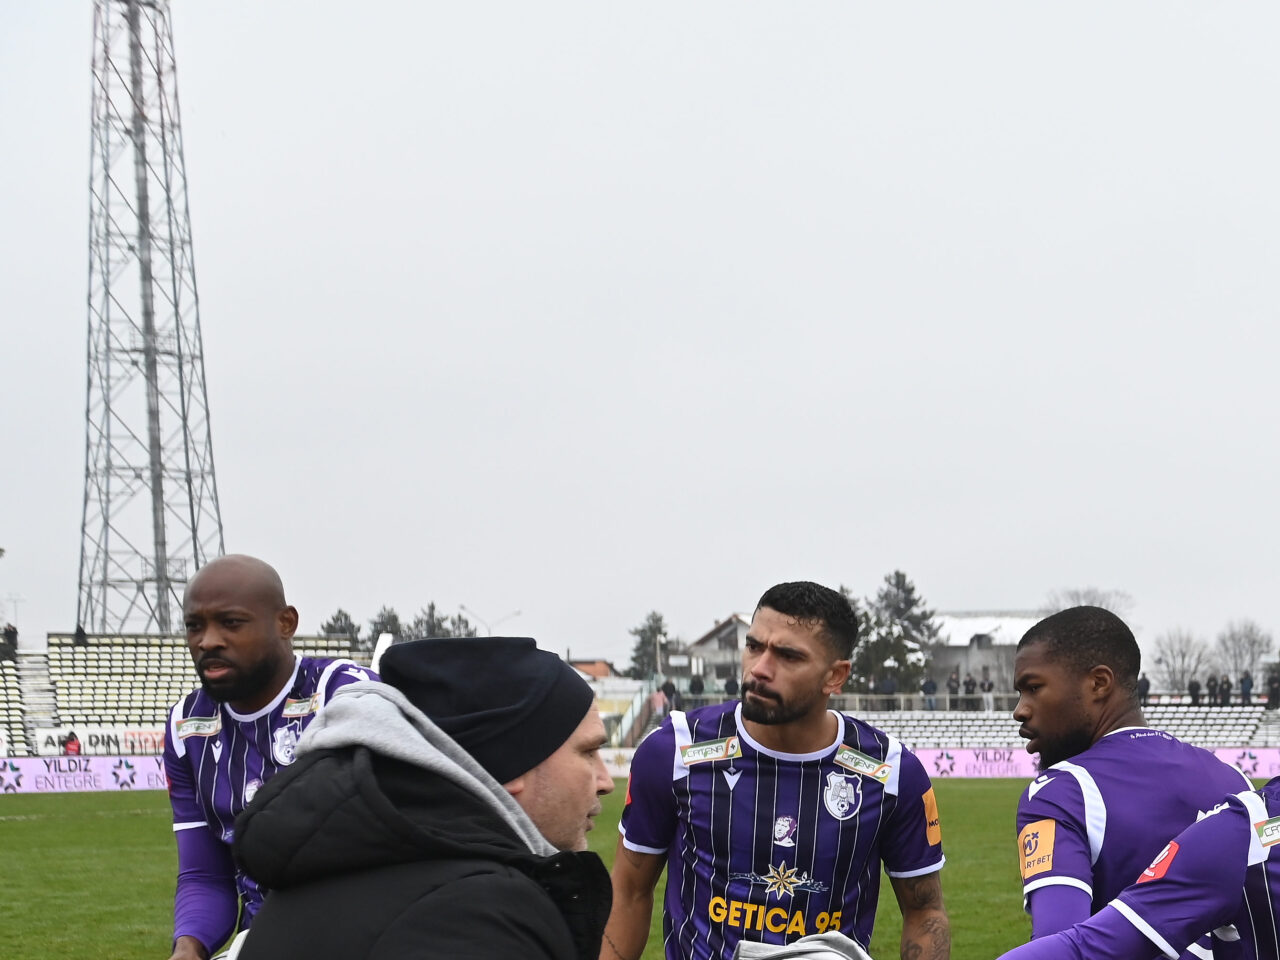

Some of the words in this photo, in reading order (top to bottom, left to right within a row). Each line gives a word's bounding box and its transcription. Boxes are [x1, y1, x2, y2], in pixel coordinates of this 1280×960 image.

[687, 745, 725, 758] CATENA
[974, 751, 1014, 763] YILDIZ
[43, 759, 92, 773] YILDIZ
[841, 751, 876, 771] CATENA
[35, 774, 100, 790] ENTEGRE
[1037, 854, 1051, 865] BET
[708, 896, 806, 935] GETICA
[815, 910, 842, 933] 95
